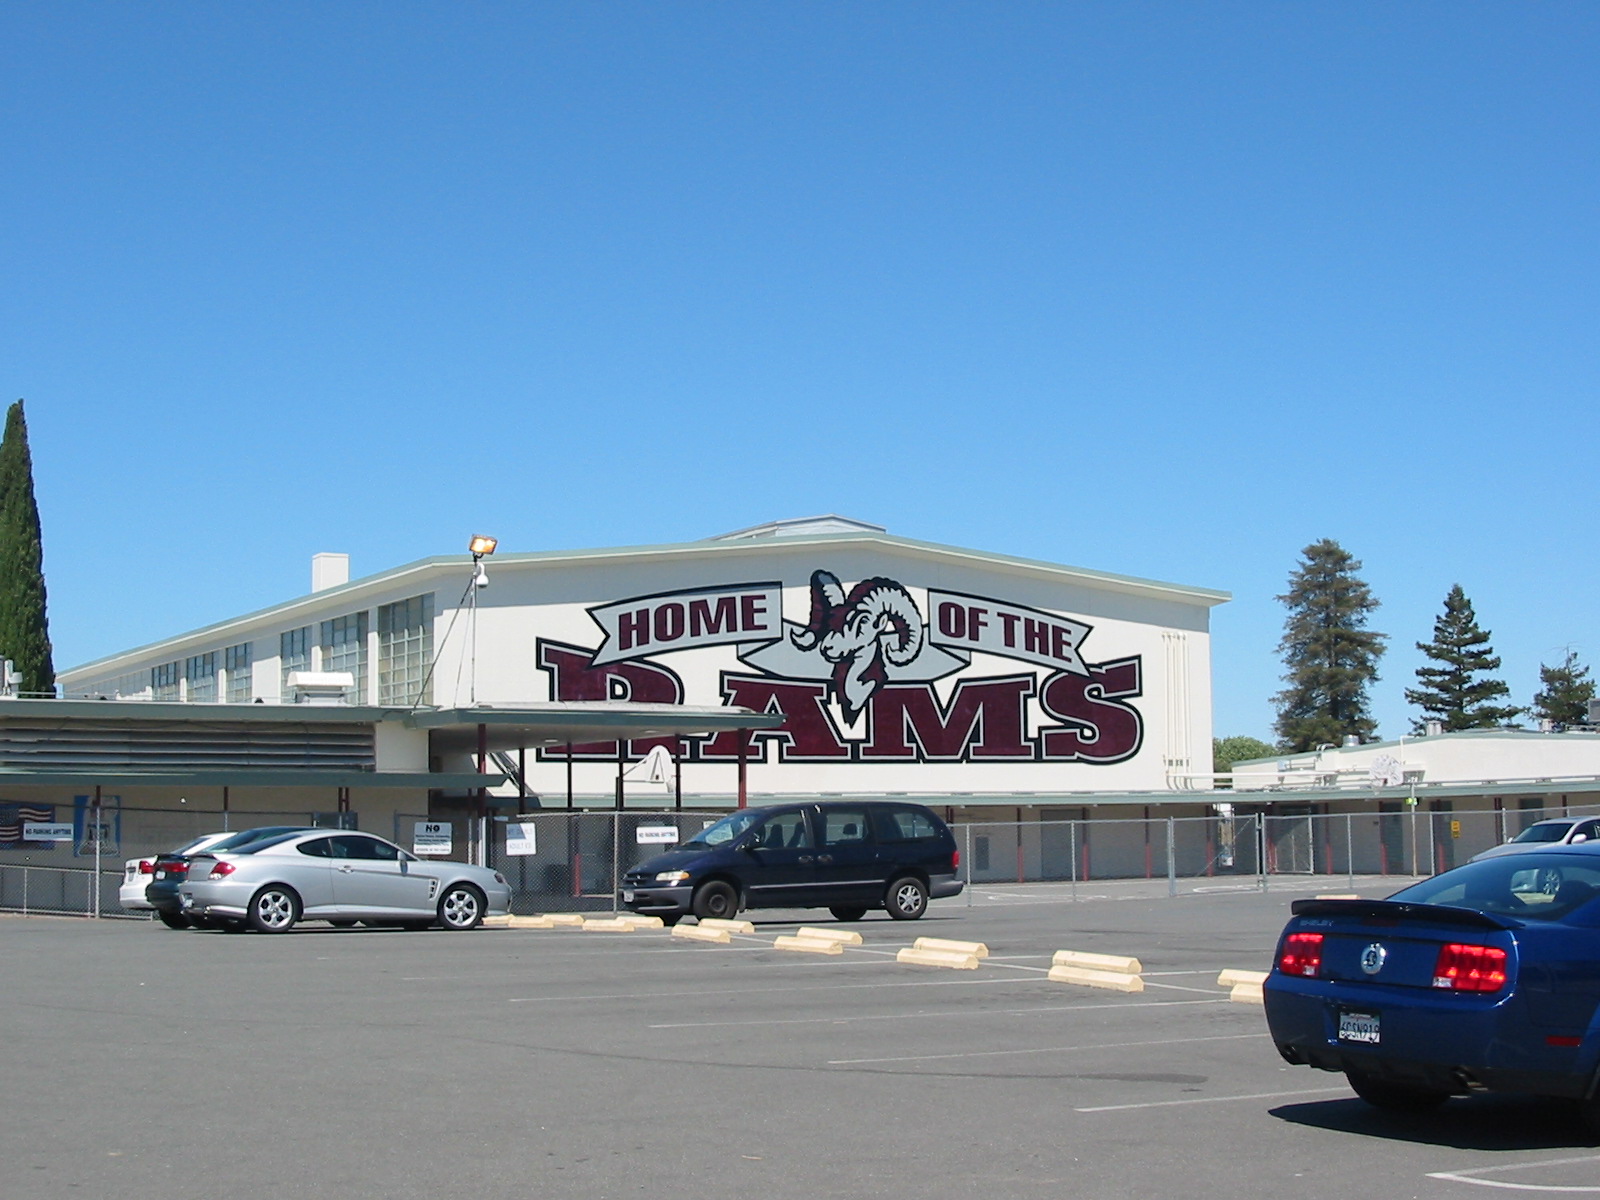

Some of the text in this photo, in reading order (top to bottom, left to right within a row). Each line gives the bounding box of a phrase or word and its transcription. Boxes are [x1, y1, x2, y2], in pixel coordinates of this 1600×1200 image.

[618, 594, 1074, 662] HOME OF THE
[536, 637, 1143, 765] RAMS
[425, 824, 440, 832] NO
